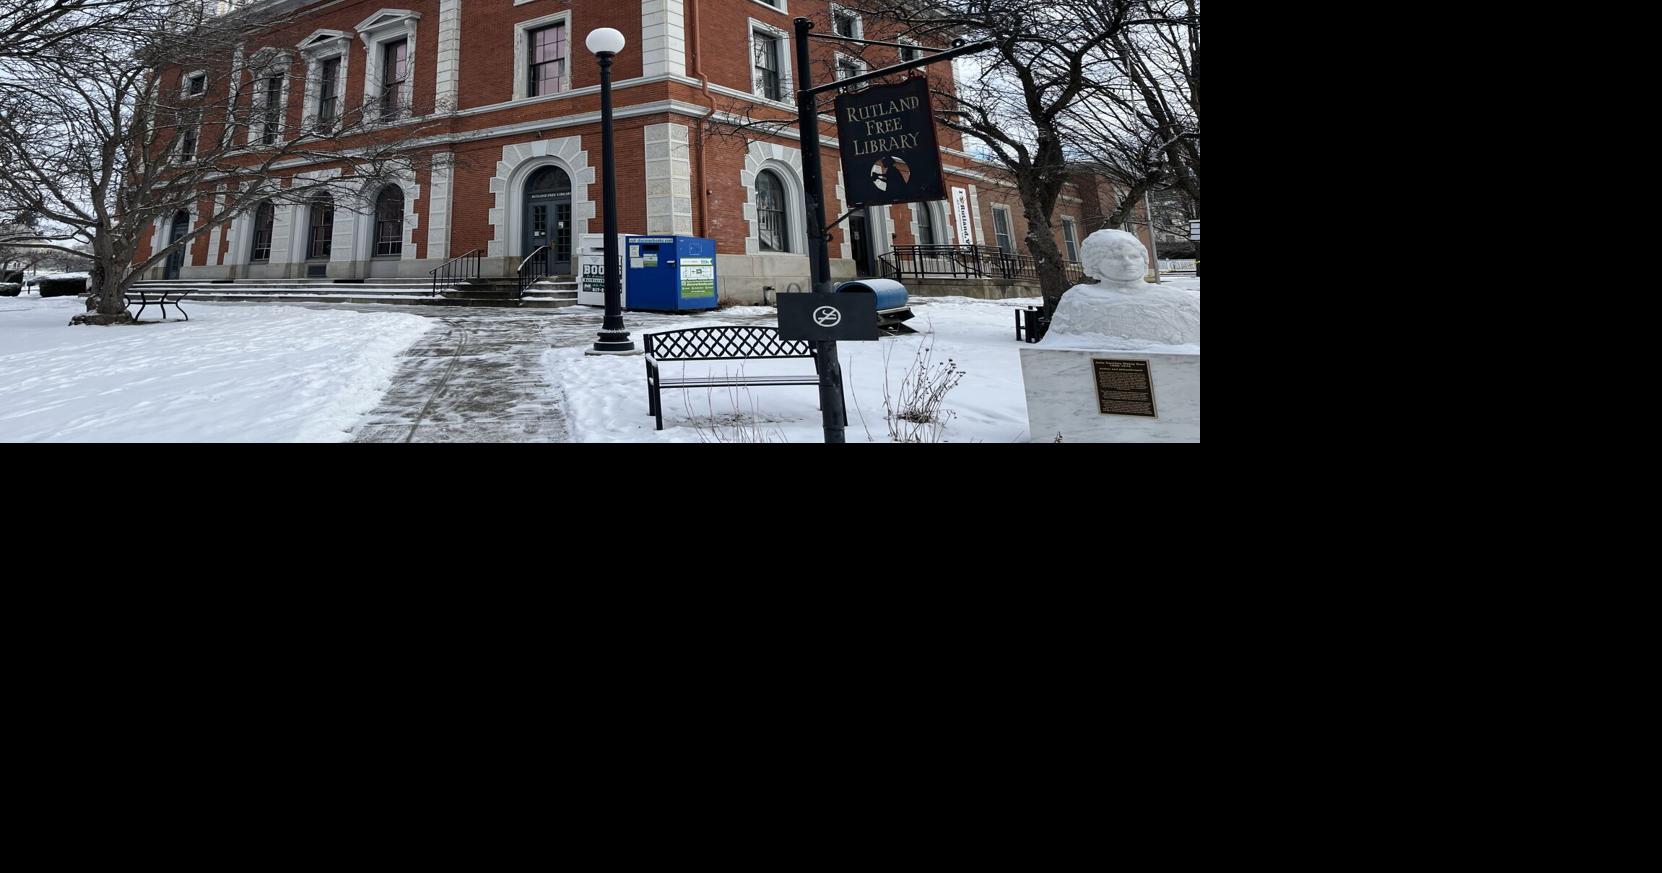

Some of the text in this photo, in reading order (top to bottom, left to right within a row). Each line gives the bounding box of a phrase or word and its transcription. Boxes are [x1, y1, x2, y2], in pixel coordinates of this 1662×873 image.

[846, 96, 919, 123] RUTLAND
[866, 117, 903, 136] FREE
[853, 132, 920, 156] LIBRARY
